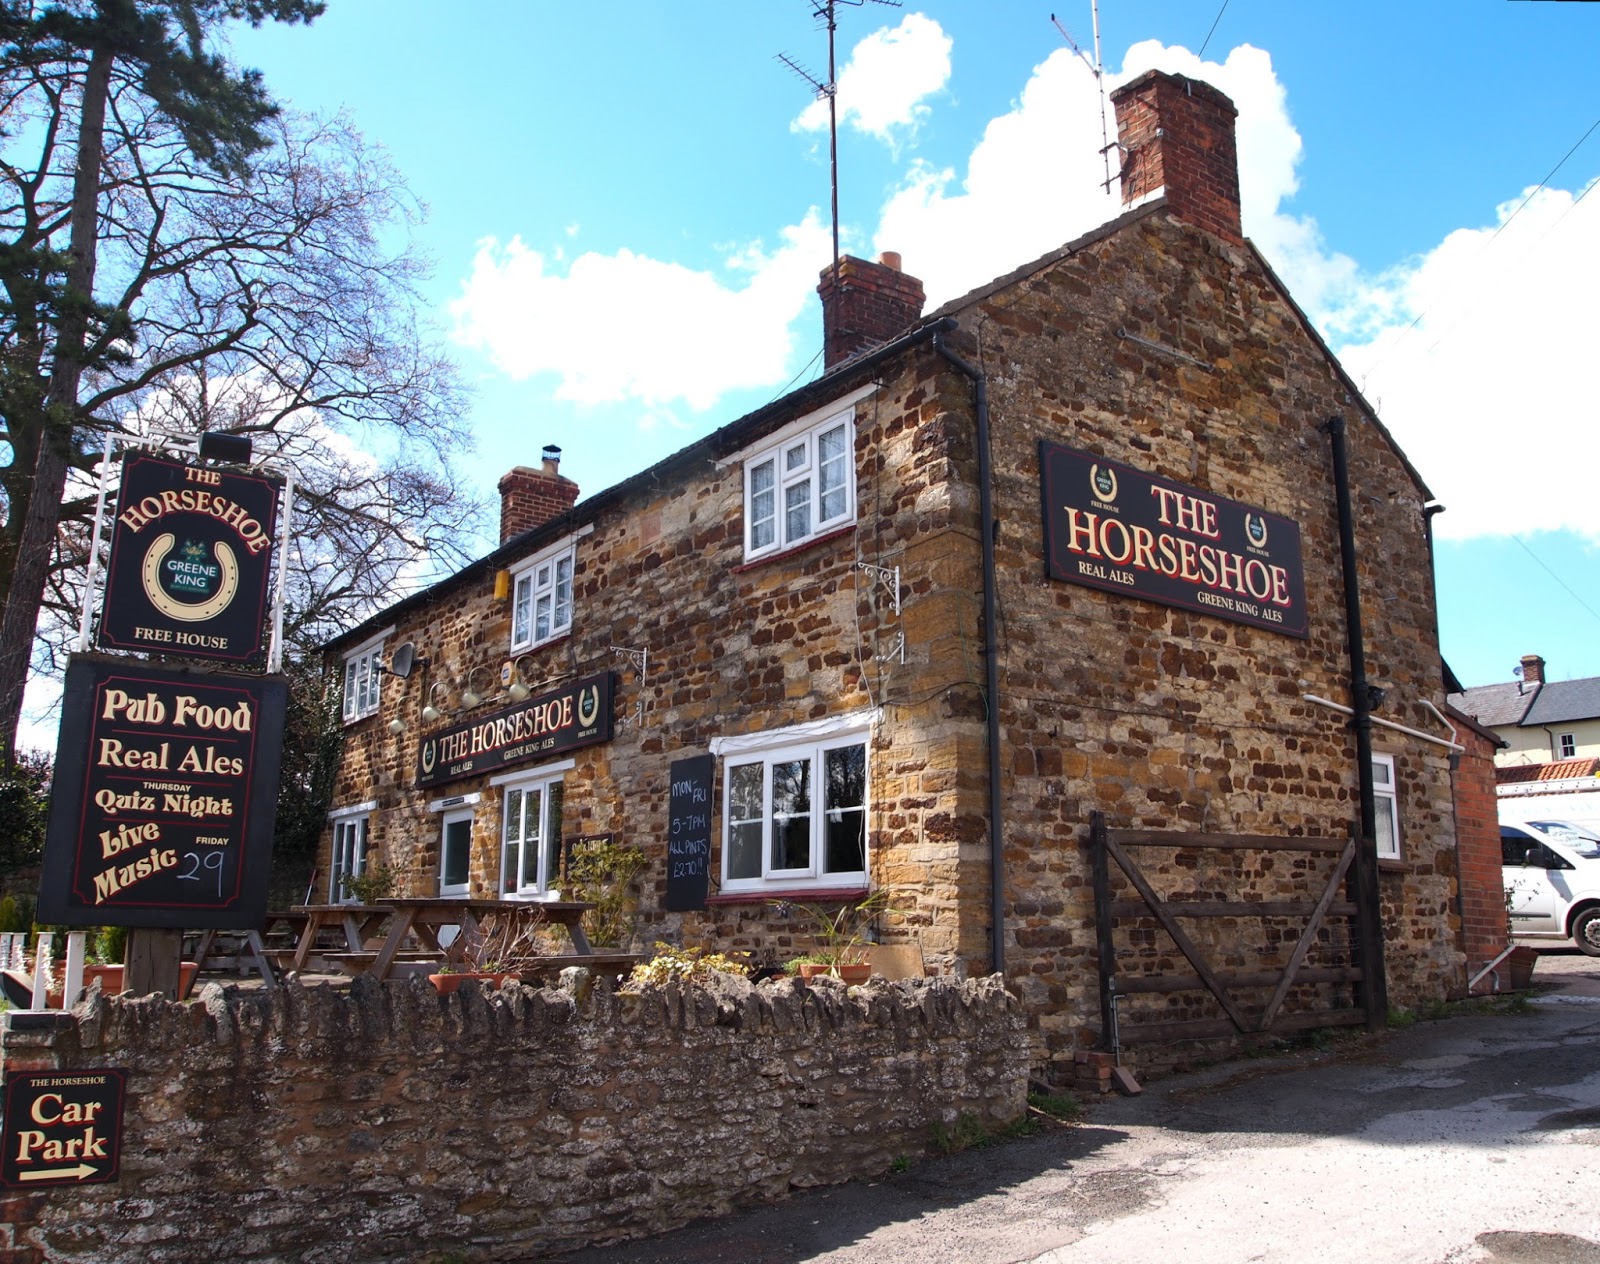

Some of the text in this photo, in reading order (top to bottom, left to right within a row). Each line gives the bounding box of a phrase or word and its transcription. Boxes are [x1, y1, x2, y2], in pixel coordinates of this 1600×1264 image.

[184, 466, 222, 486] THE
[118, 489, 272, 554] HORSESHOE
[1151, 484, 1219, 538] THE
[167, 560, 217, 577] GREENE
[1063, 506, 1290, 605] HORSESHOE
[174, 573, 206, 588] KING
[1078, 561, 1135, 586] REAL ALES
[1197, 591, 1283, 623] GREENE KING ALES
[134, 627, 229, 649] FREE HOUSE
[102, 689, 252, 732] Pub Food
[440, 694, 573, 762] THE HORSESHOE
[97, 738, 244, 776] Real Ales
[503, 738, 555, 760] GREENE KING ALES
[450, 761, 473, 775] REAL ALES
[143, 781, 192, 792] THURSDAY
[692, 788, 706, 803] FRI
[95, 789, 233, 818] Quiz Night
[672, 814, 706, 834] 5-7PM
[99, 823, 160, 859] Live
[195, 836, 229, 846] FRIDAY
[669, 839, 707, 855] ALL PINTS
[93, 848, 178, 905] Music
[176, 851, 225, 898] 29
[30, 1076, 106, 1087] THE HORSESHOE
[31, 1093, 102, 1125] Car
[15, 1126, 108, 1162] Park
